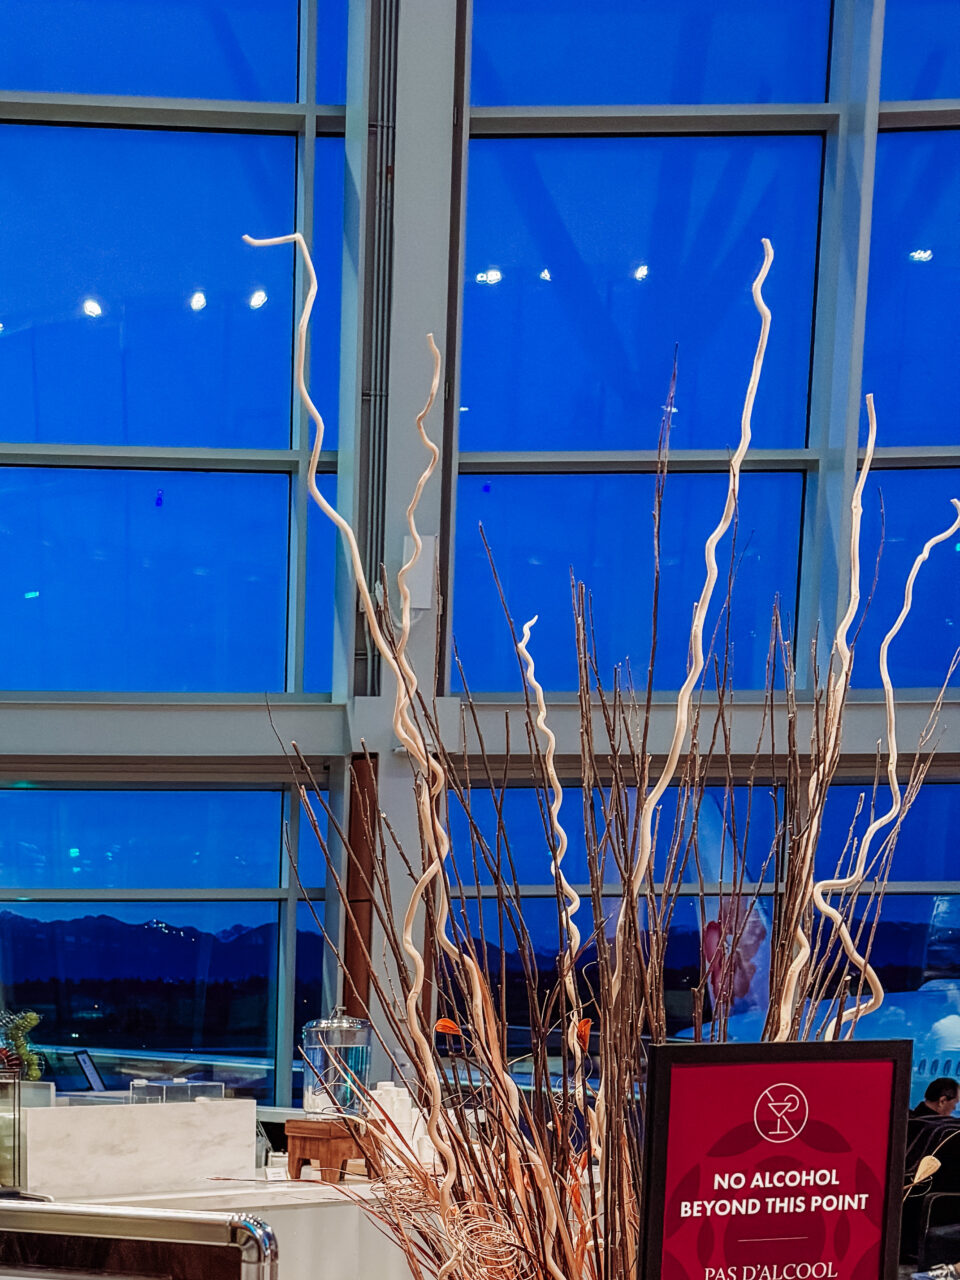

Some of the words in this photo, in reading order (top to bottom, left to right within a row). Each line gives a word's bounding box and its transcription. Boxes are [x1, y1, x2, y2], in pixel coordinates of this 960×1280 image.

[713, 1172, 746, 1190] NO
[750, 1169, 840, 1188] ALCOHOL
[680, 1198, 761, 1218] BEYOND
[765, 1196, 806, 1214] THIS
[811, 1194, 869, 1212] POINT
